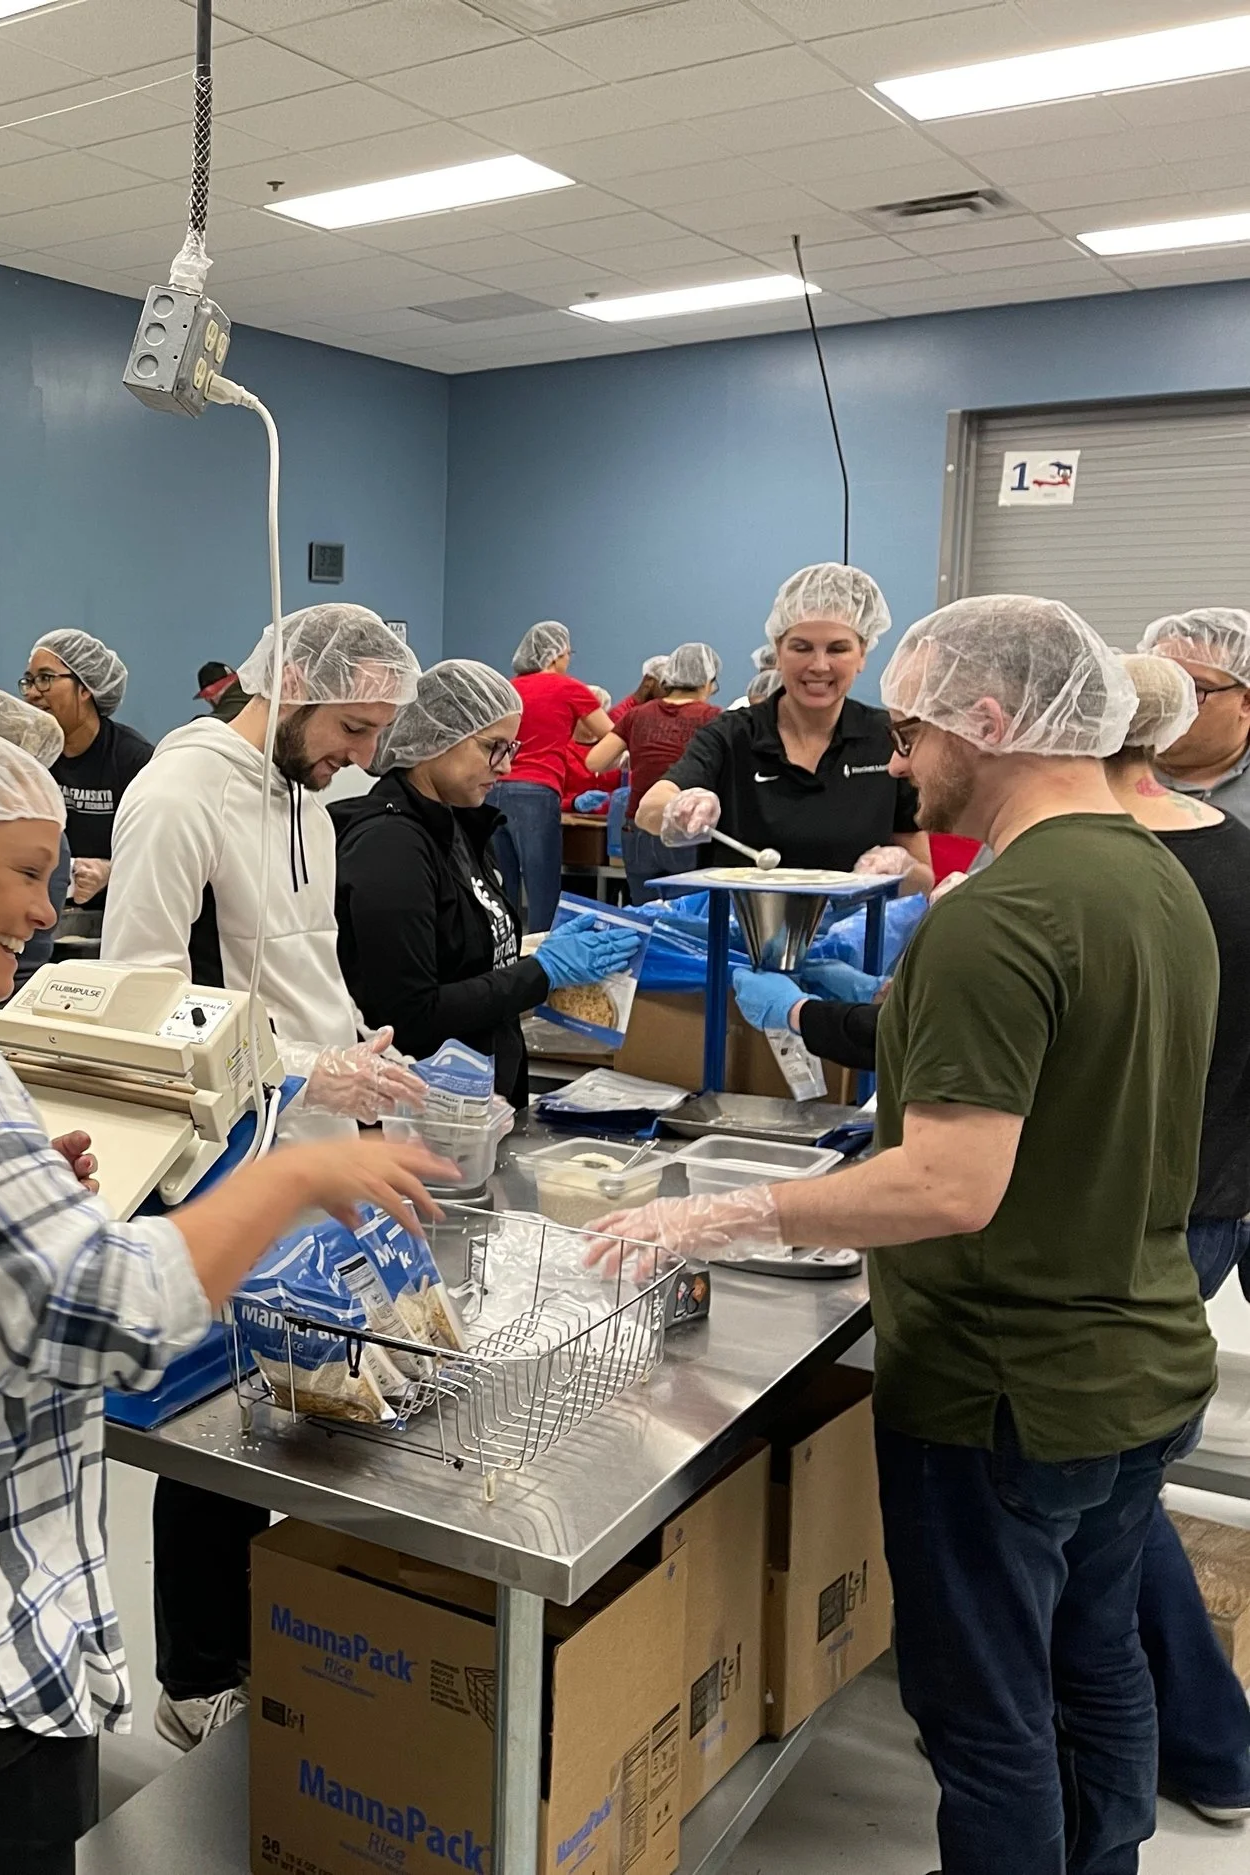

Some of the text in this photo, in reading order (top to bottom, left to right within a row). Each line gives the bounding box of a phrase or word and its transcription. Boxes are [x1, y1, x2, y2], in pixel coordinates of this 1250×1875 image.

[1010, 461, 1030, 491] 1
[270, 1603, 415, 1684] MannaPack
[323, 1656, 354, 1681] Rice
[299, 1758, 484, 1874] MannaPack
[367, 1831, 407, 1865] Rice
